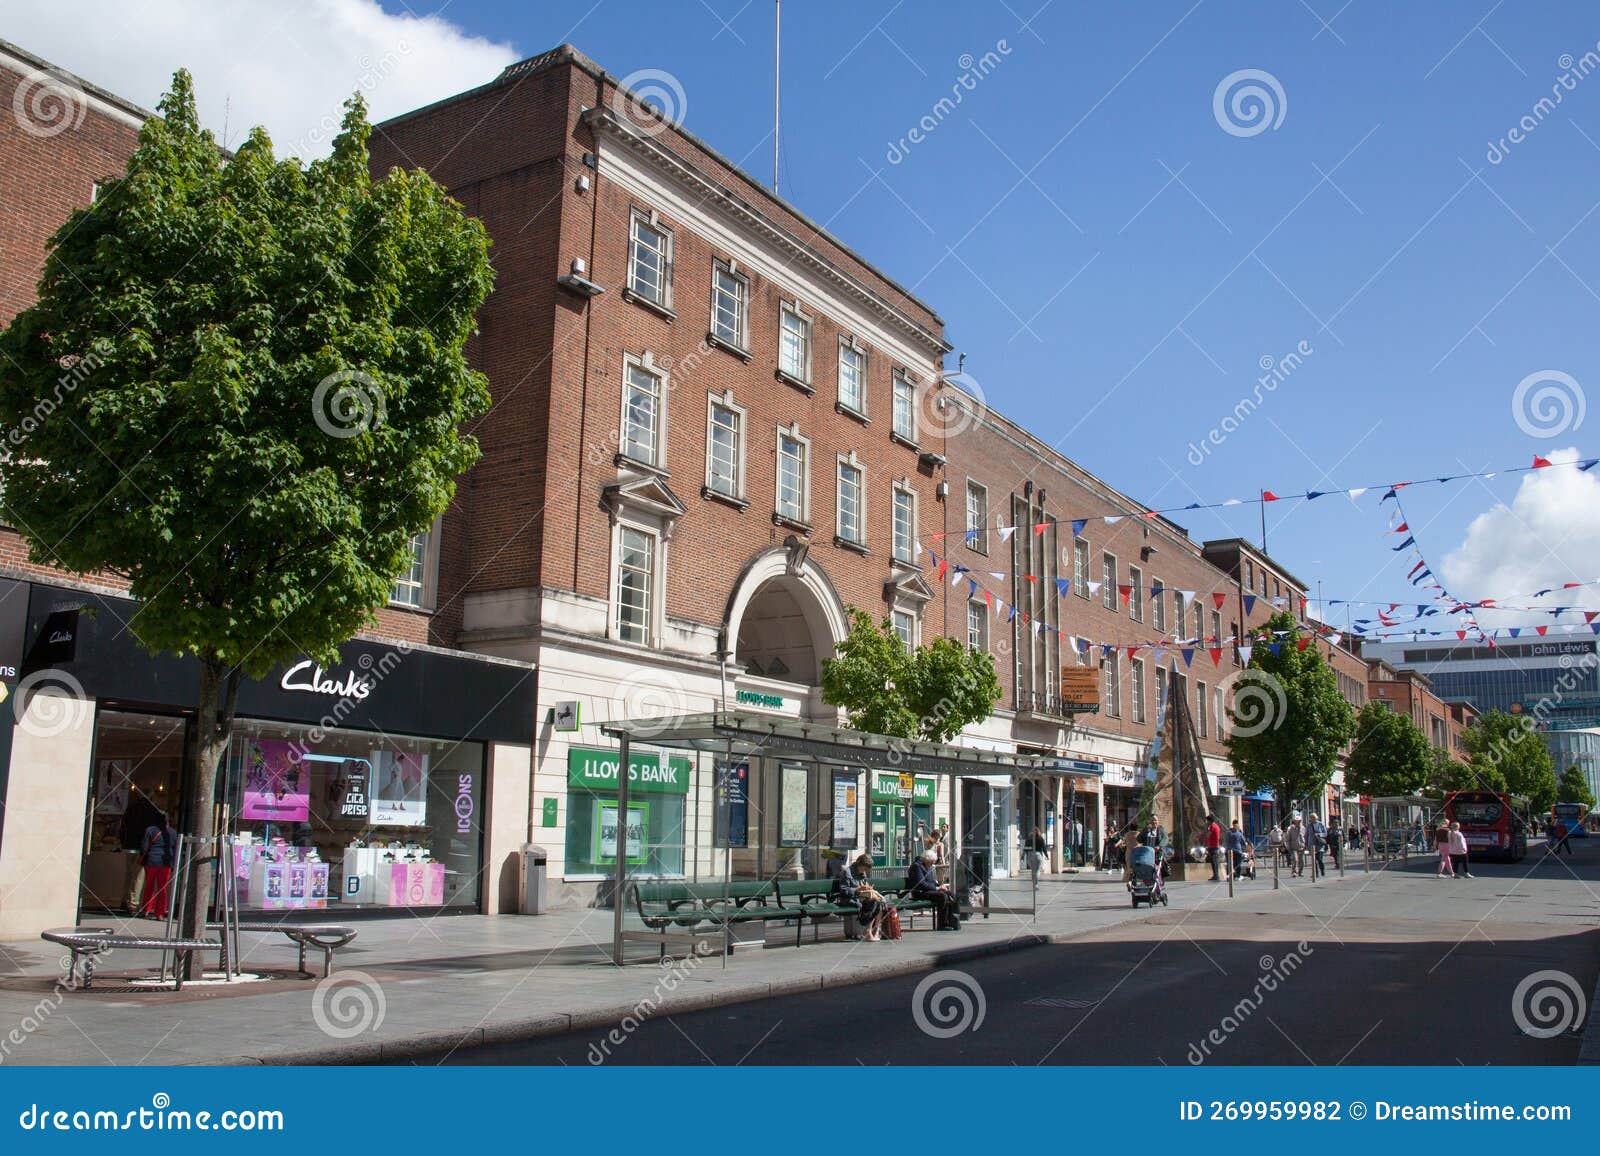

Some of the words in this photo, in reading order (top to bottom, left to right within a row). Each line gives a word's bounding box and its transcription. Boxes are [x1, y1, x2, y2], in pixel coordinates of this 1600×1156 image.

[1531, 643, 1556, 656] John
[1559, 642, 1590, 653] Lewis
[281, 660, 370, 699] Clarks
[585, 760, 637, 780] LLOYS
[641, 765, 677, 783] BANK
[913, 783, 929, 798] ANK
[455, 774, 473, 833] ICONS
